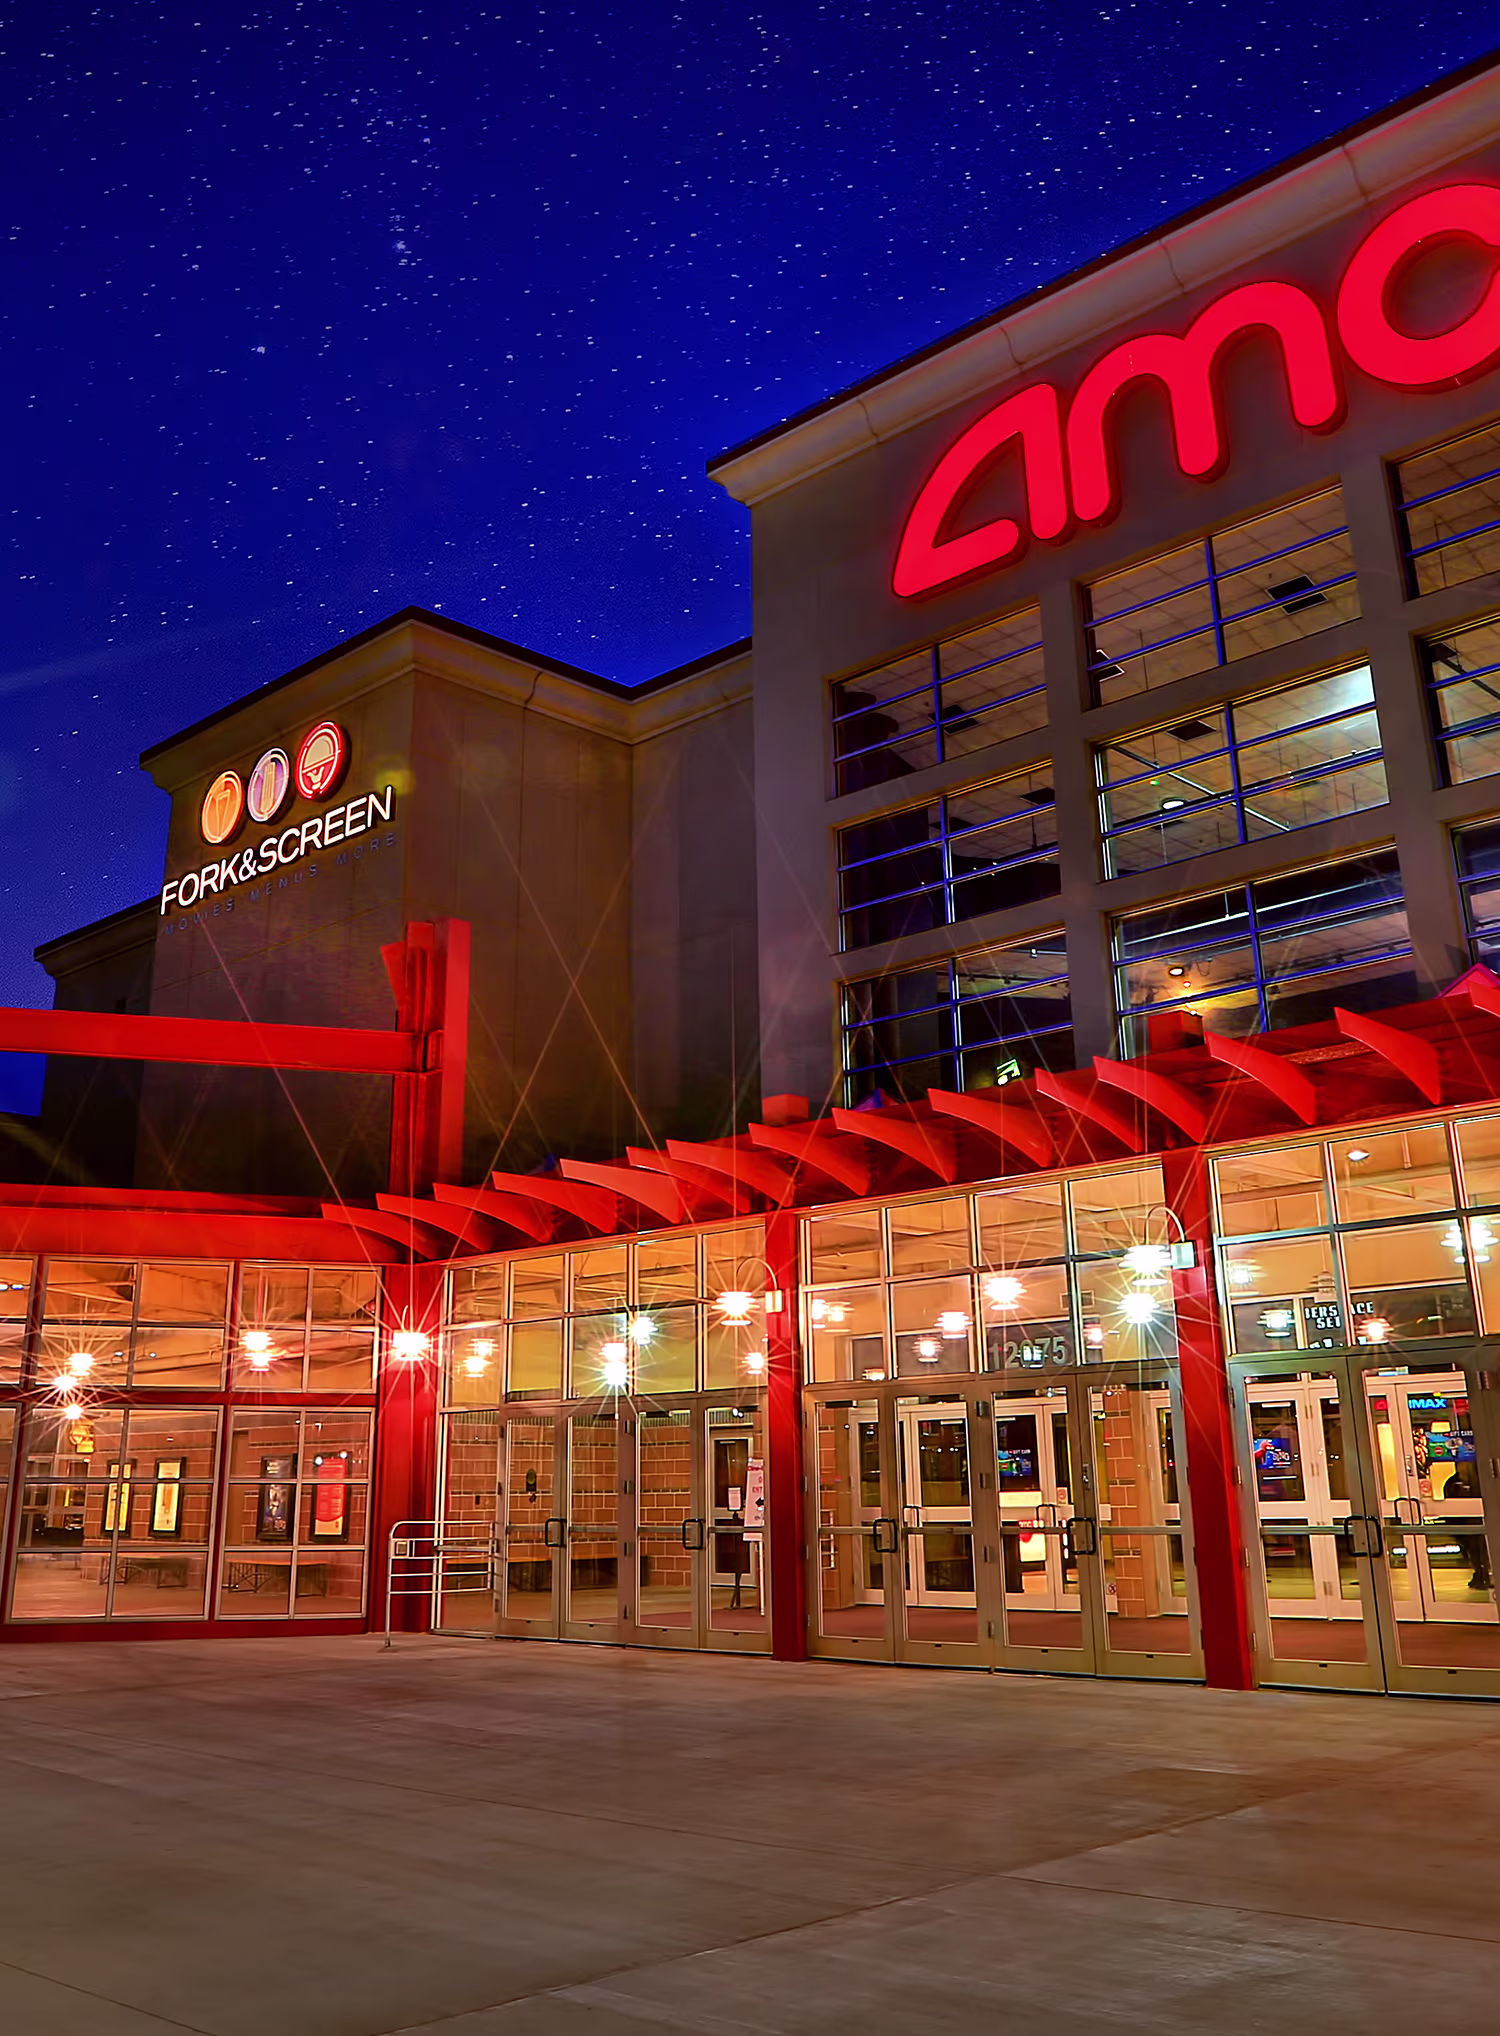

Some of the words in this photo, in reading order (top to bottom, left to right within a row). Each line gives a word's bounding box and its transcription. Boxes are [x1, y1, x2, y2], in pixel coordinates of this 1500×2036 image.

[892, 183, 1500, 600] amc
[160, 785, 392, 916] FORK&SCREEN
[165, 898, 235, 936] MOVIES
[249, 864, 318, 901] MENUS
[336, 832, 396, 866] MORE
[1408, 1398, 1447, 1409] IMAX
